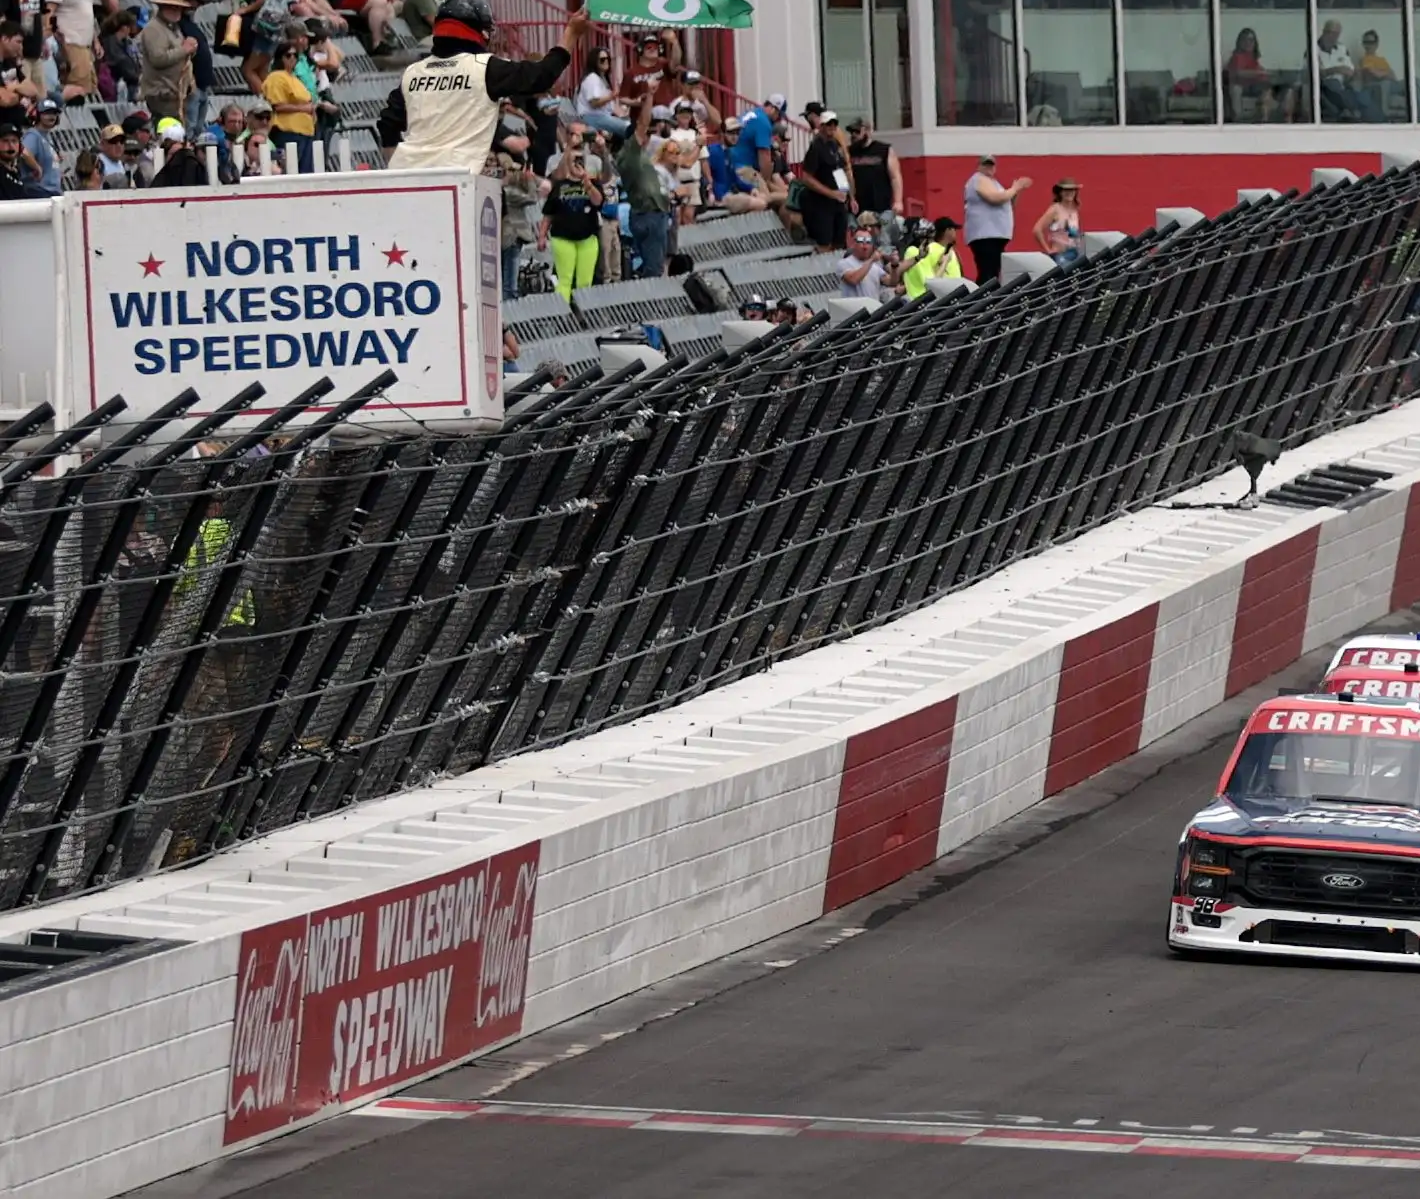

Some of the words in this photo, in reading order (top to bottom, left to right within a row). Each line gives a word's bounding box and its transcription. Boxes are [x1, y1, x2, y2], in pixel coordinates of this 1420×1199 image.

[599, 10, 630, 22] GET
[408, 74, 472, 92] OFFICIAL
[185, 235, 361, 277] NORTH
[110, 279, 442, 328] WILKESBORO
[134, 328, 420, 376] SPEEDWAY
[1330, 875, 1360, 888] Ford
[305, 911, 364, 995] NORTH
[376, 869, 486, 972] WILKESBORO
[329, 965, 454, 1096] SPEEDWAY
